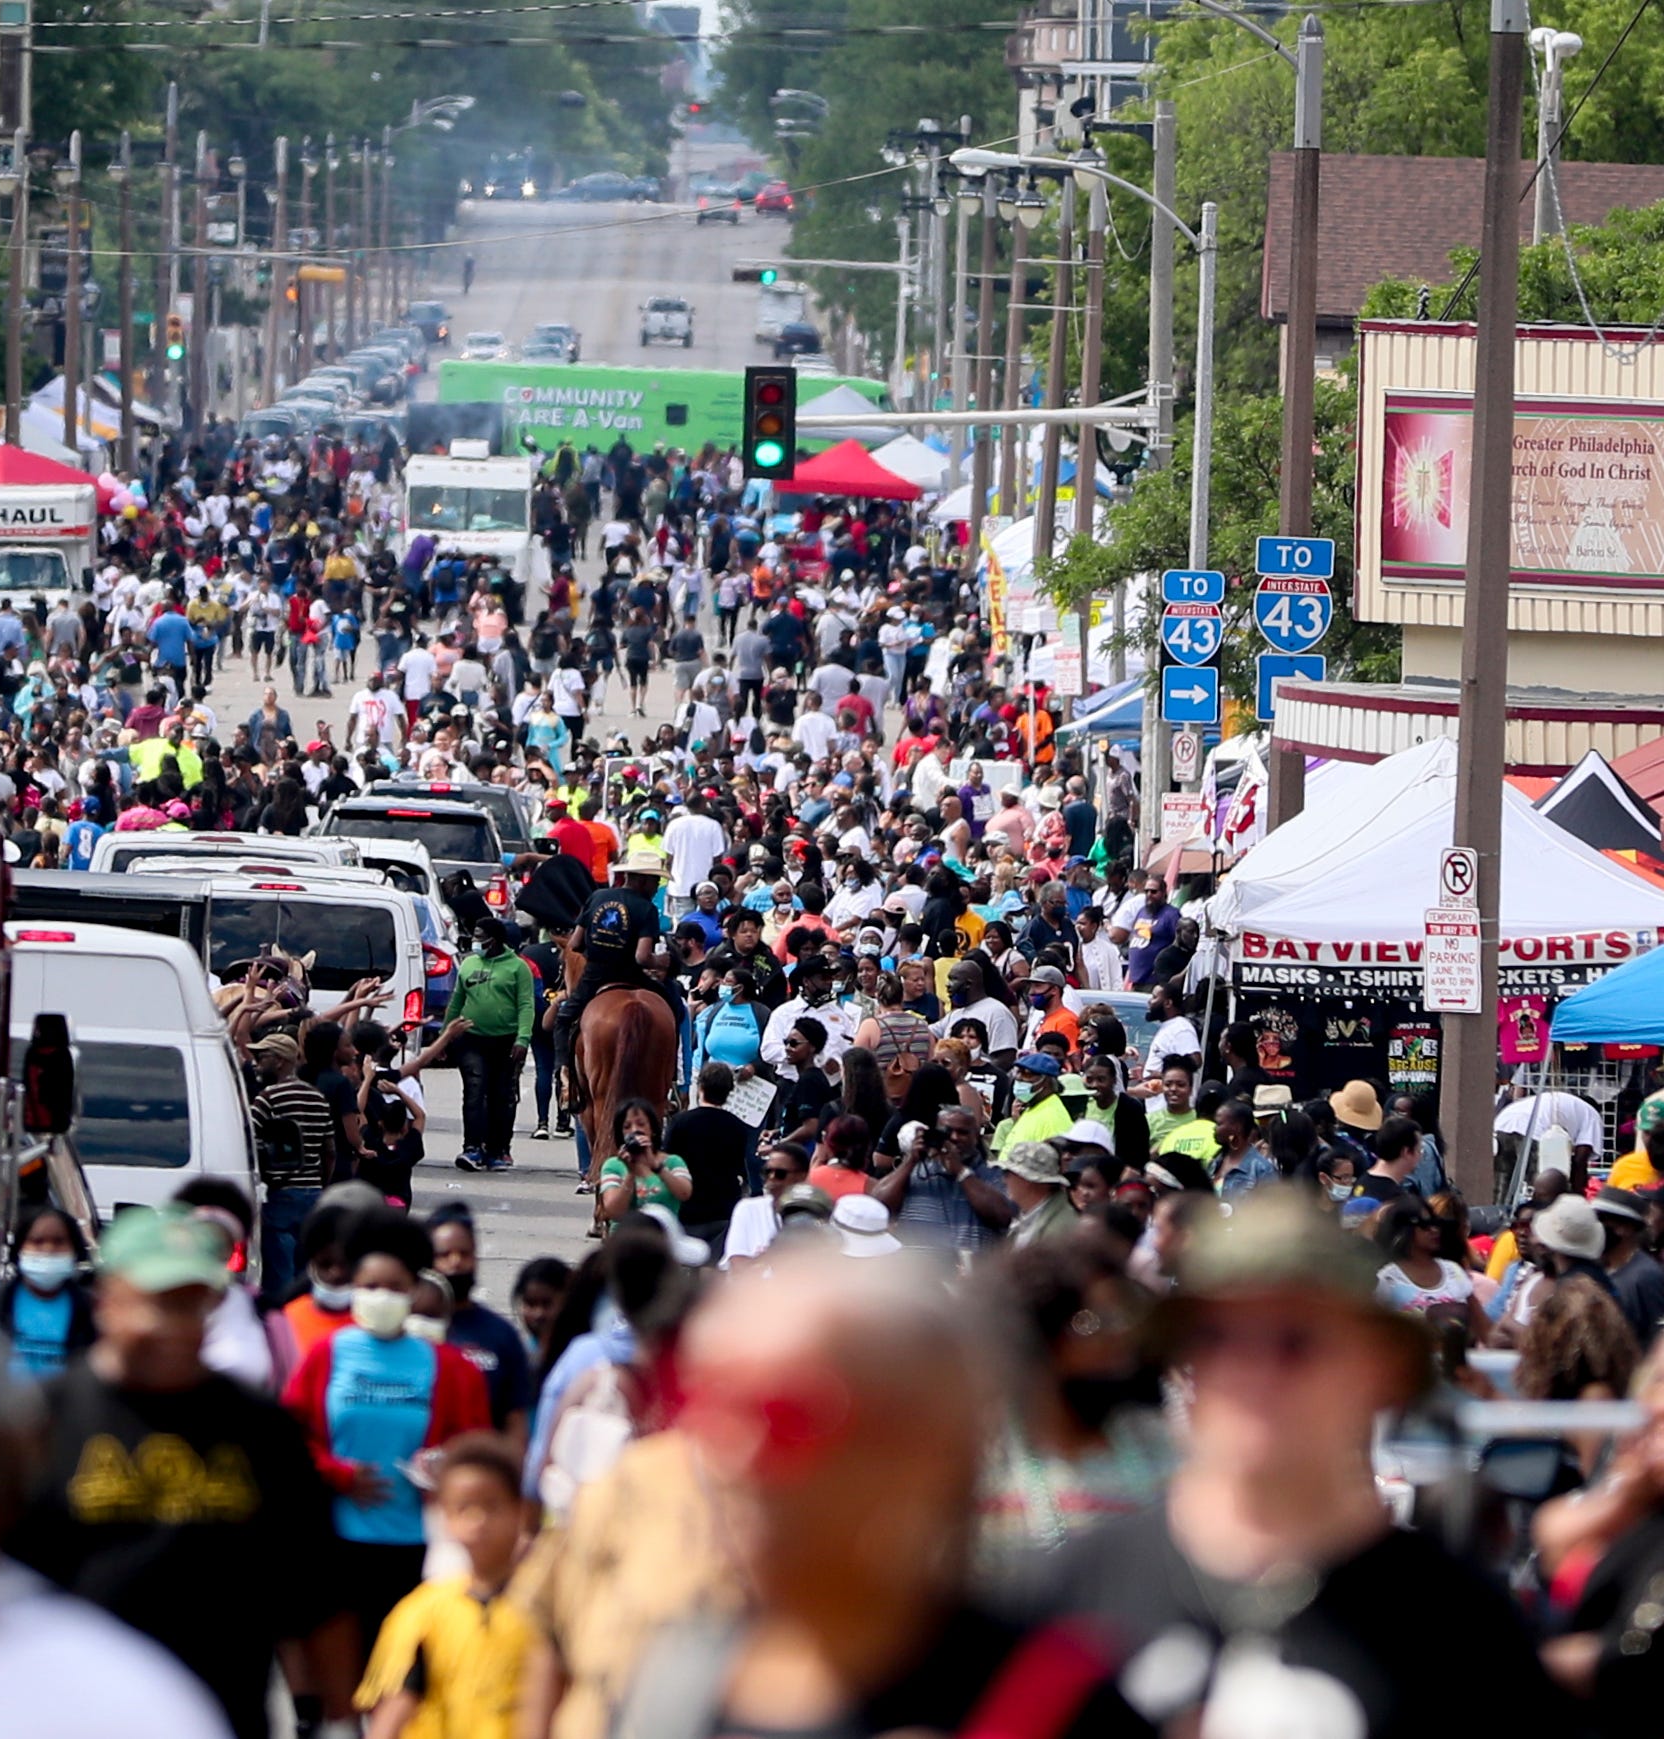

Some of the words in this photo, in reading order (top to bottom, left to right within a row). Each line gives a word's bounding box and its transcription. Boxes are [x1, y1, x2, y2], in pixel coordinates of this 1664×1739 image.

[504, 386, 643, 409] COMMUNITY
[1512, 435, 1564, 451] Greater
[1569, 436, 1655, 457] Philadelphia
[1511, 461, 1536, 477] urch
[1541, 462, 1556, 478] of
[1558, 462, 1586, 479] God
[1590, 463, 1604, 479] In
[1608, 463, 1651, 481] Christ
[1277, 545, 1313, 569] TO
[1179, 577, 1209, 596] TO
[1267, 580, 1321, 593] INTERSTATE
[1170, 607, 1214, 616] INTERSTATE
[1262, 595, 1324, 639] 43
[1167, 619, 1216, 654] 43
[1429, 912, 1473, 924] TEMPORARY
[1444, 937, 1459, 951] NO
[1429, 951, 1476, 965] PARKING
[1242, 966, 1321, 985] MASKS
[1340, 969, 1425, 988] T-SHIRT
[1433, 965, 1454, 976] JUNE
[1497, 968, 1566, 985] CKETS
[1286, 986, 1304, 995] WE
[1314, 987, 1368, 997] ACCEPT
[1388, 1058, 1437, 1071] BECAUSE
